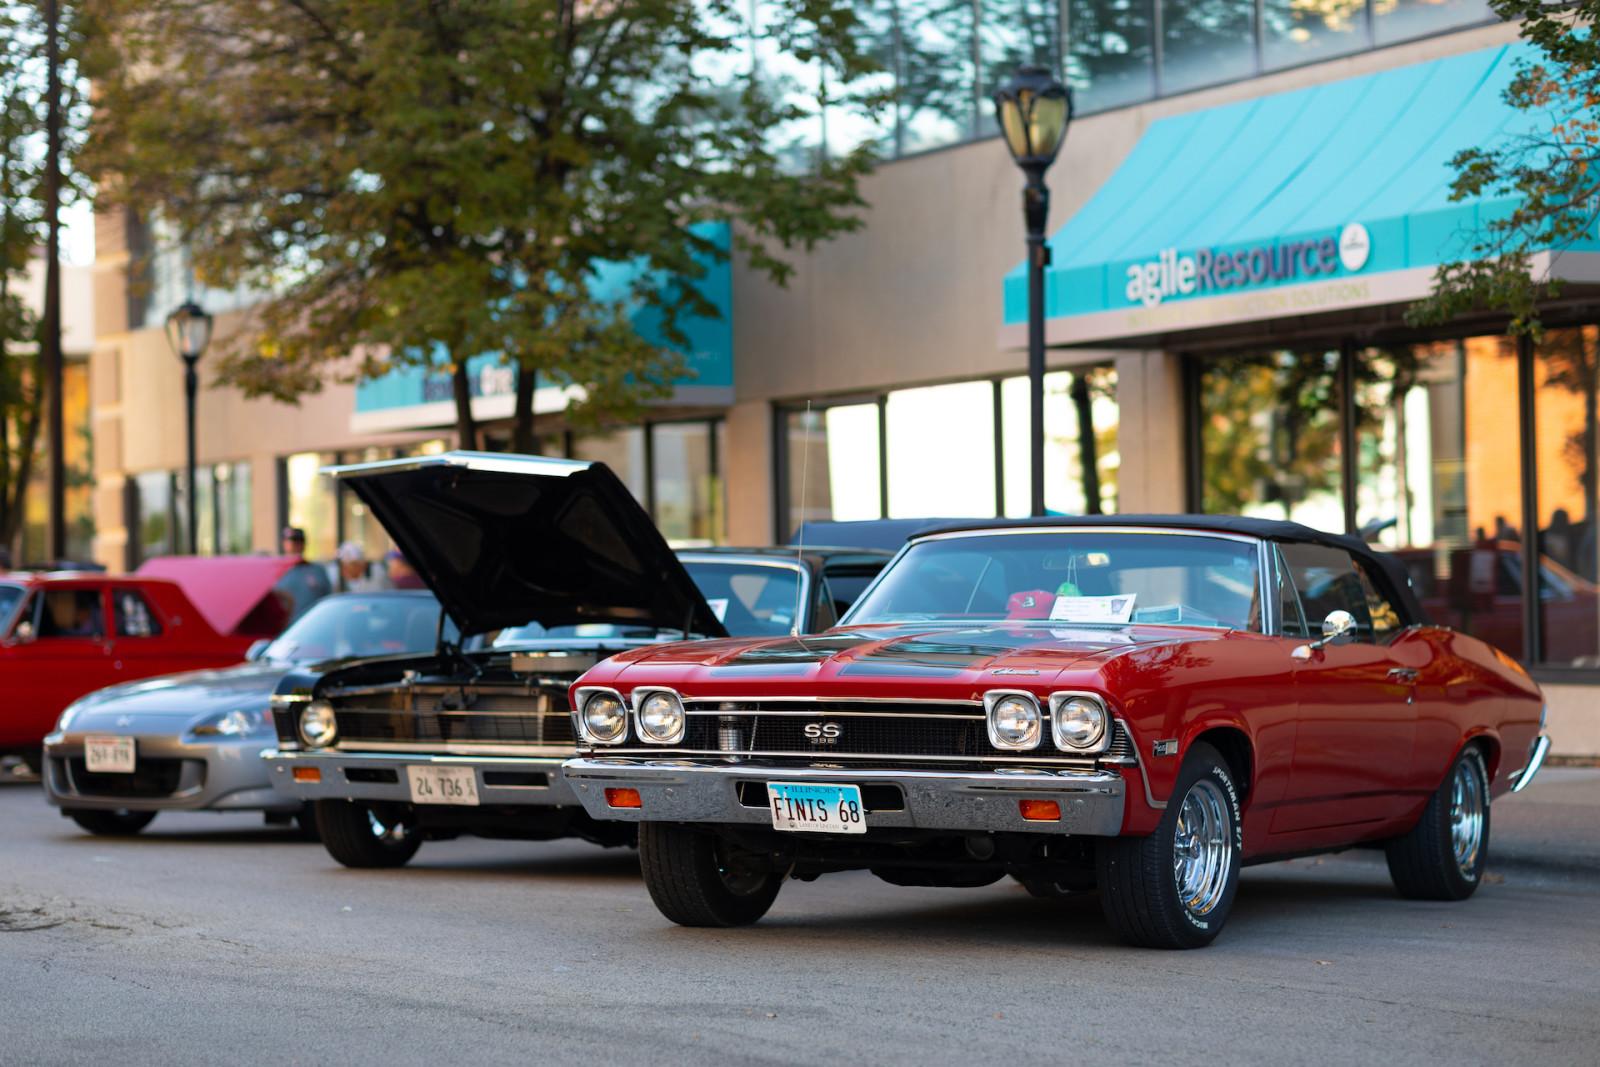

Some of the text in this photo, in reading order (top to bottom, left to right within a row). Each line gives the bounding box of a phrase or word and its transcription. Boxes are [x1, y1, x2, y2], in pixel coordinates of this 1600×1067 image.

[804, 724, 840, 737] SS
[438, 777, 463, 796] 736
[1212, 767, 1240, 820] SPORTSMAN
[773, 798, 860, 823] FINIS 68
